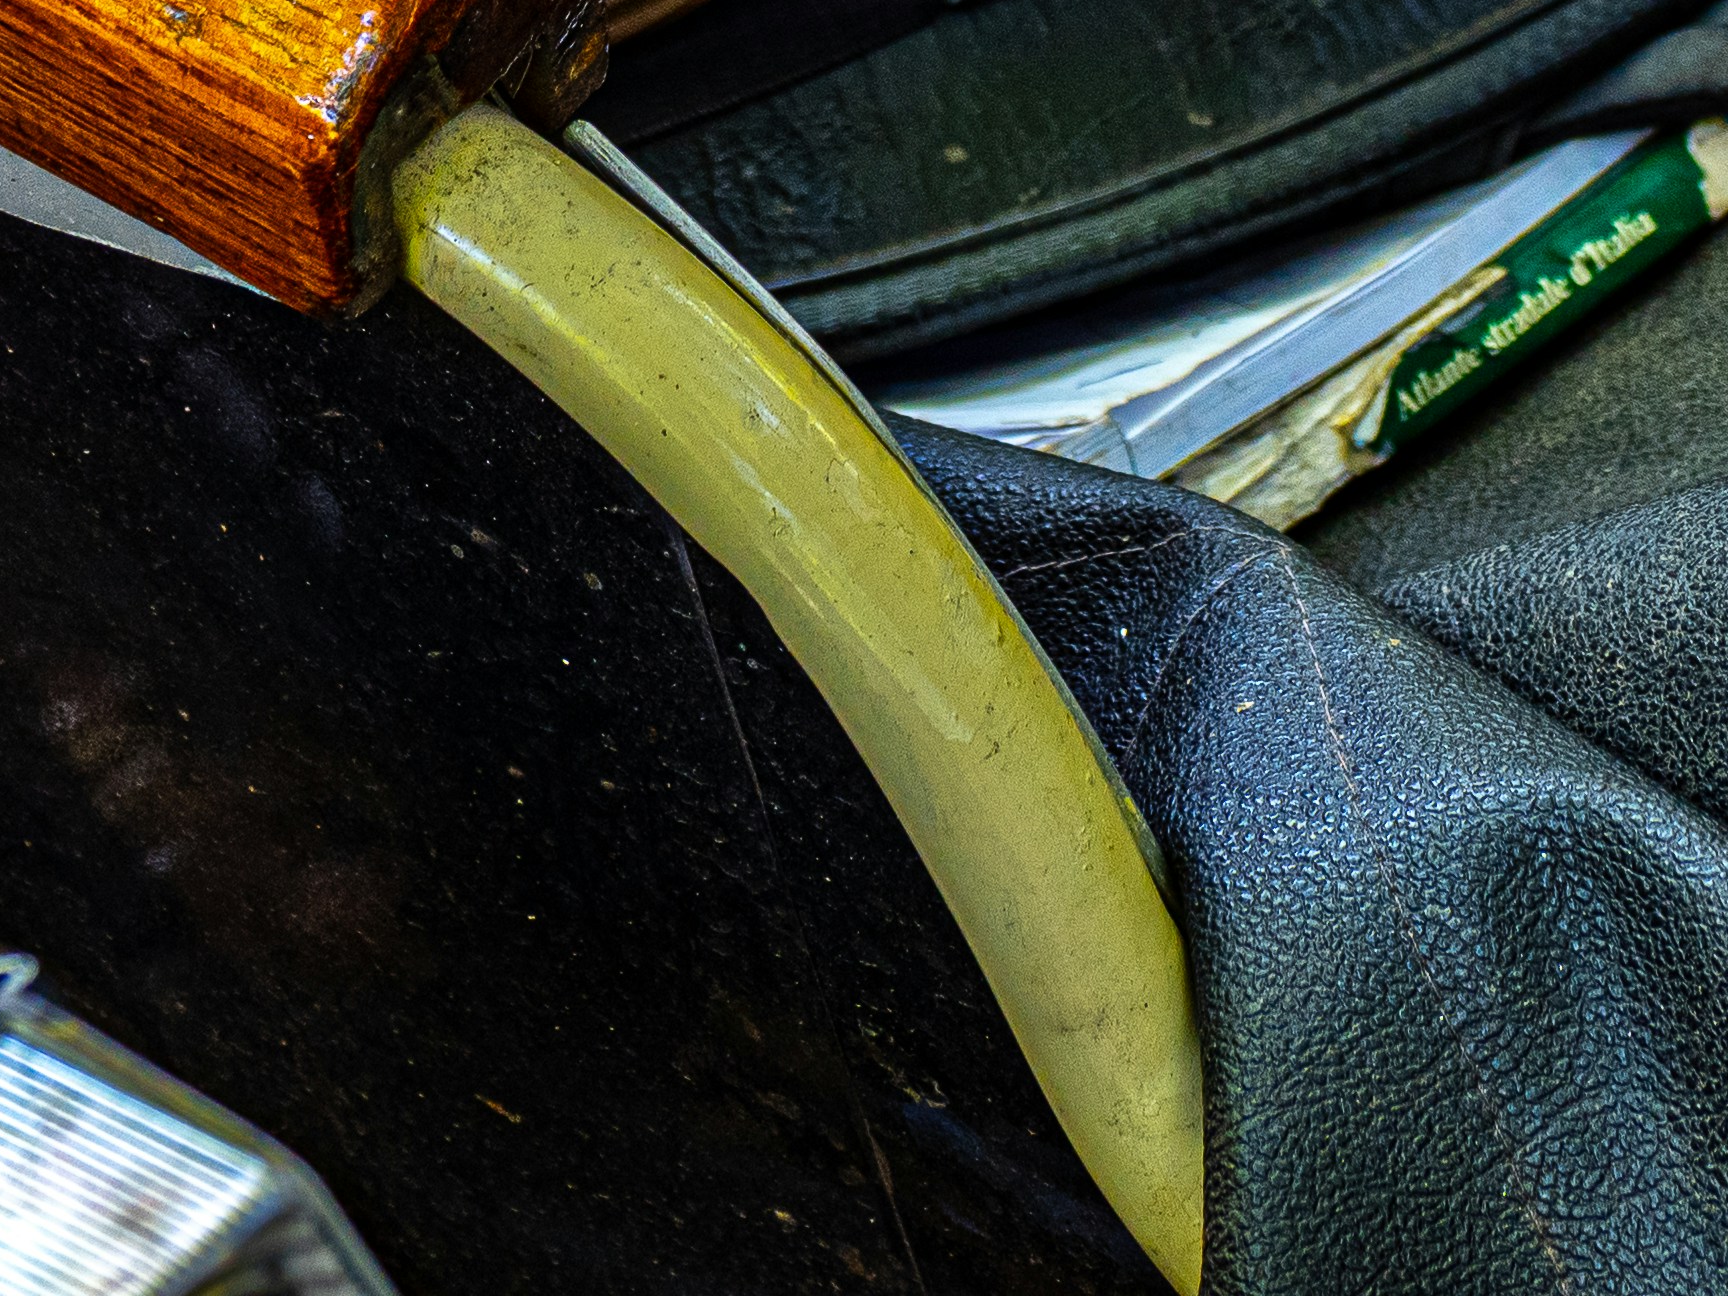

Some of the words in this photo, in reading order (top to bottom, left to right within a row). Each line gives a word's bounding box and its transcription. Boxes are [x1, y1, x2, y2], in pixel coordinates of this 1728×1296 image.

[1397, 347, 1481, 420] Atlante
[1484, 277, 1570, 354] stradale
[1571, 211, 1658, 286] d'Italia
